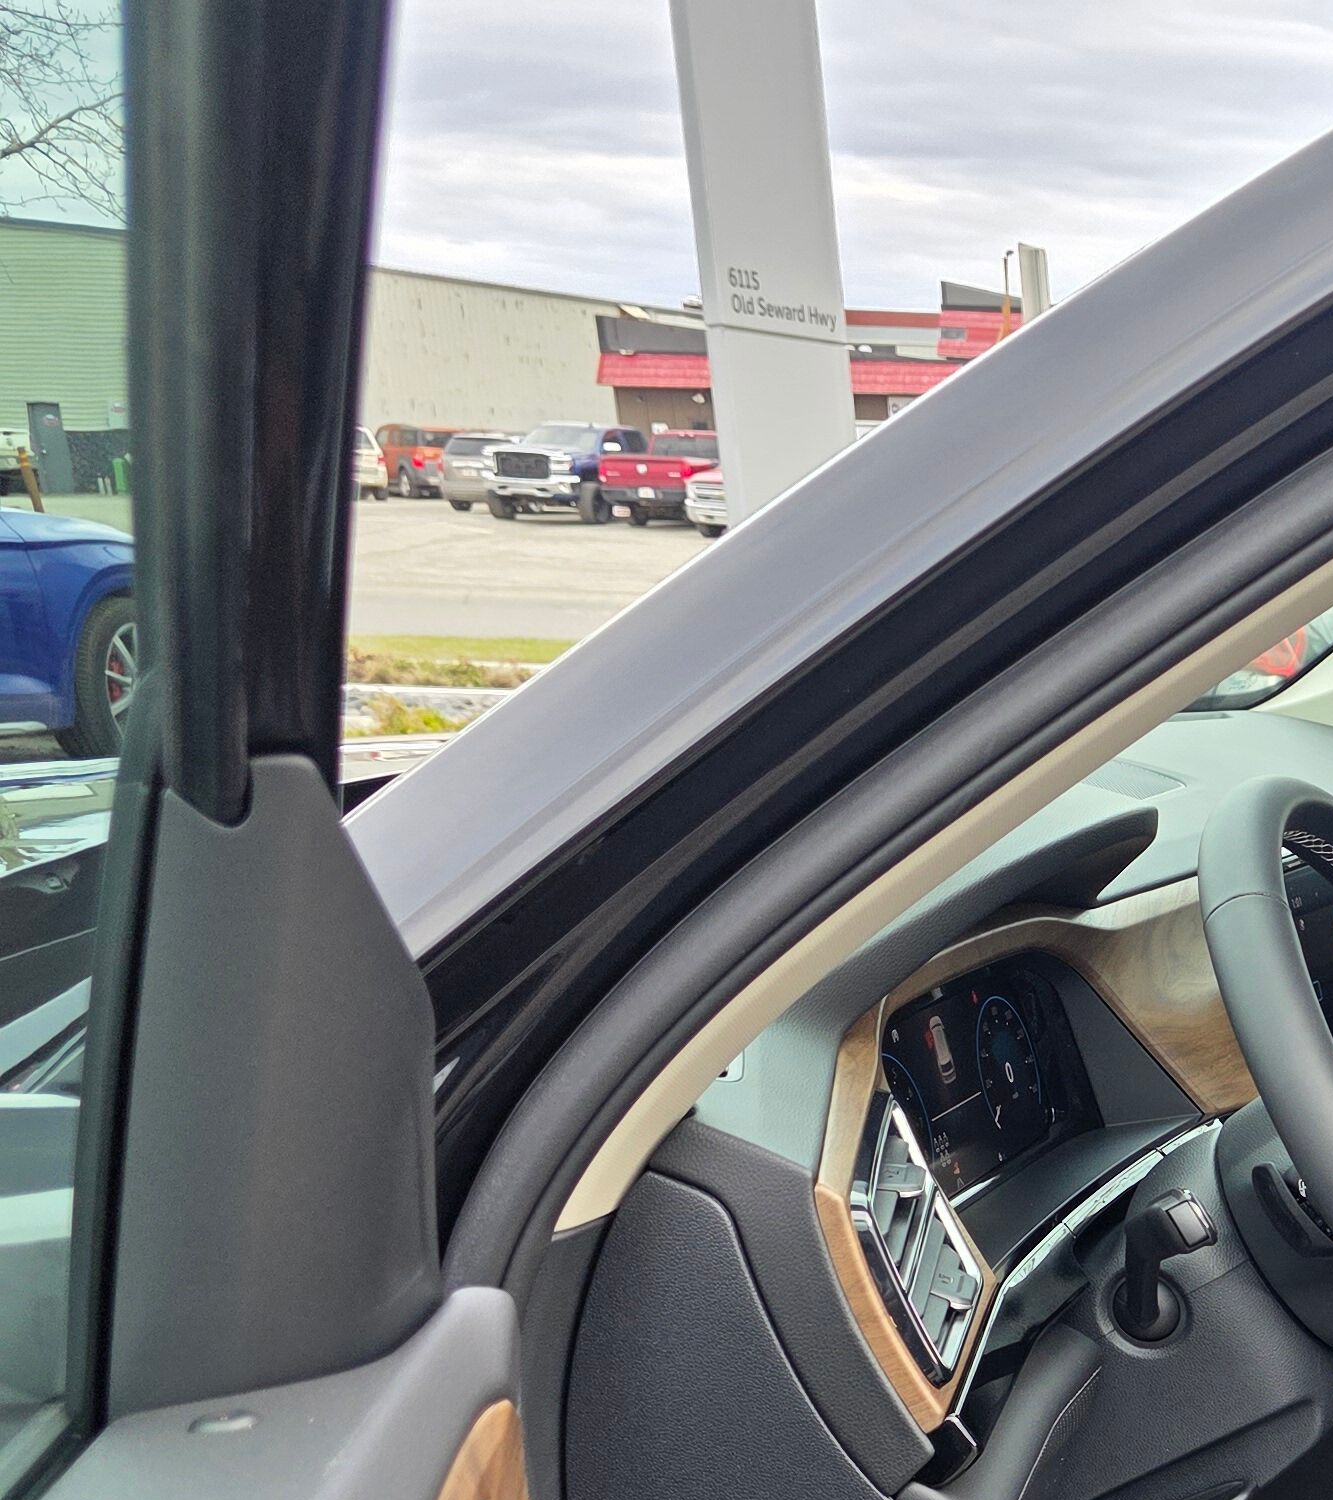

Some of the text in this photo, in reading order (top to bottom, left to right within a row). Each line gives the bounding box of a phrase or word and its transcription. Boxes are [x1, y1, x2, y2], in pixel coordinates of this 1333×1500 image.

[729, 267, 760, 291] 6115
[732, 293, 837, 333] Old Seward Hwy
